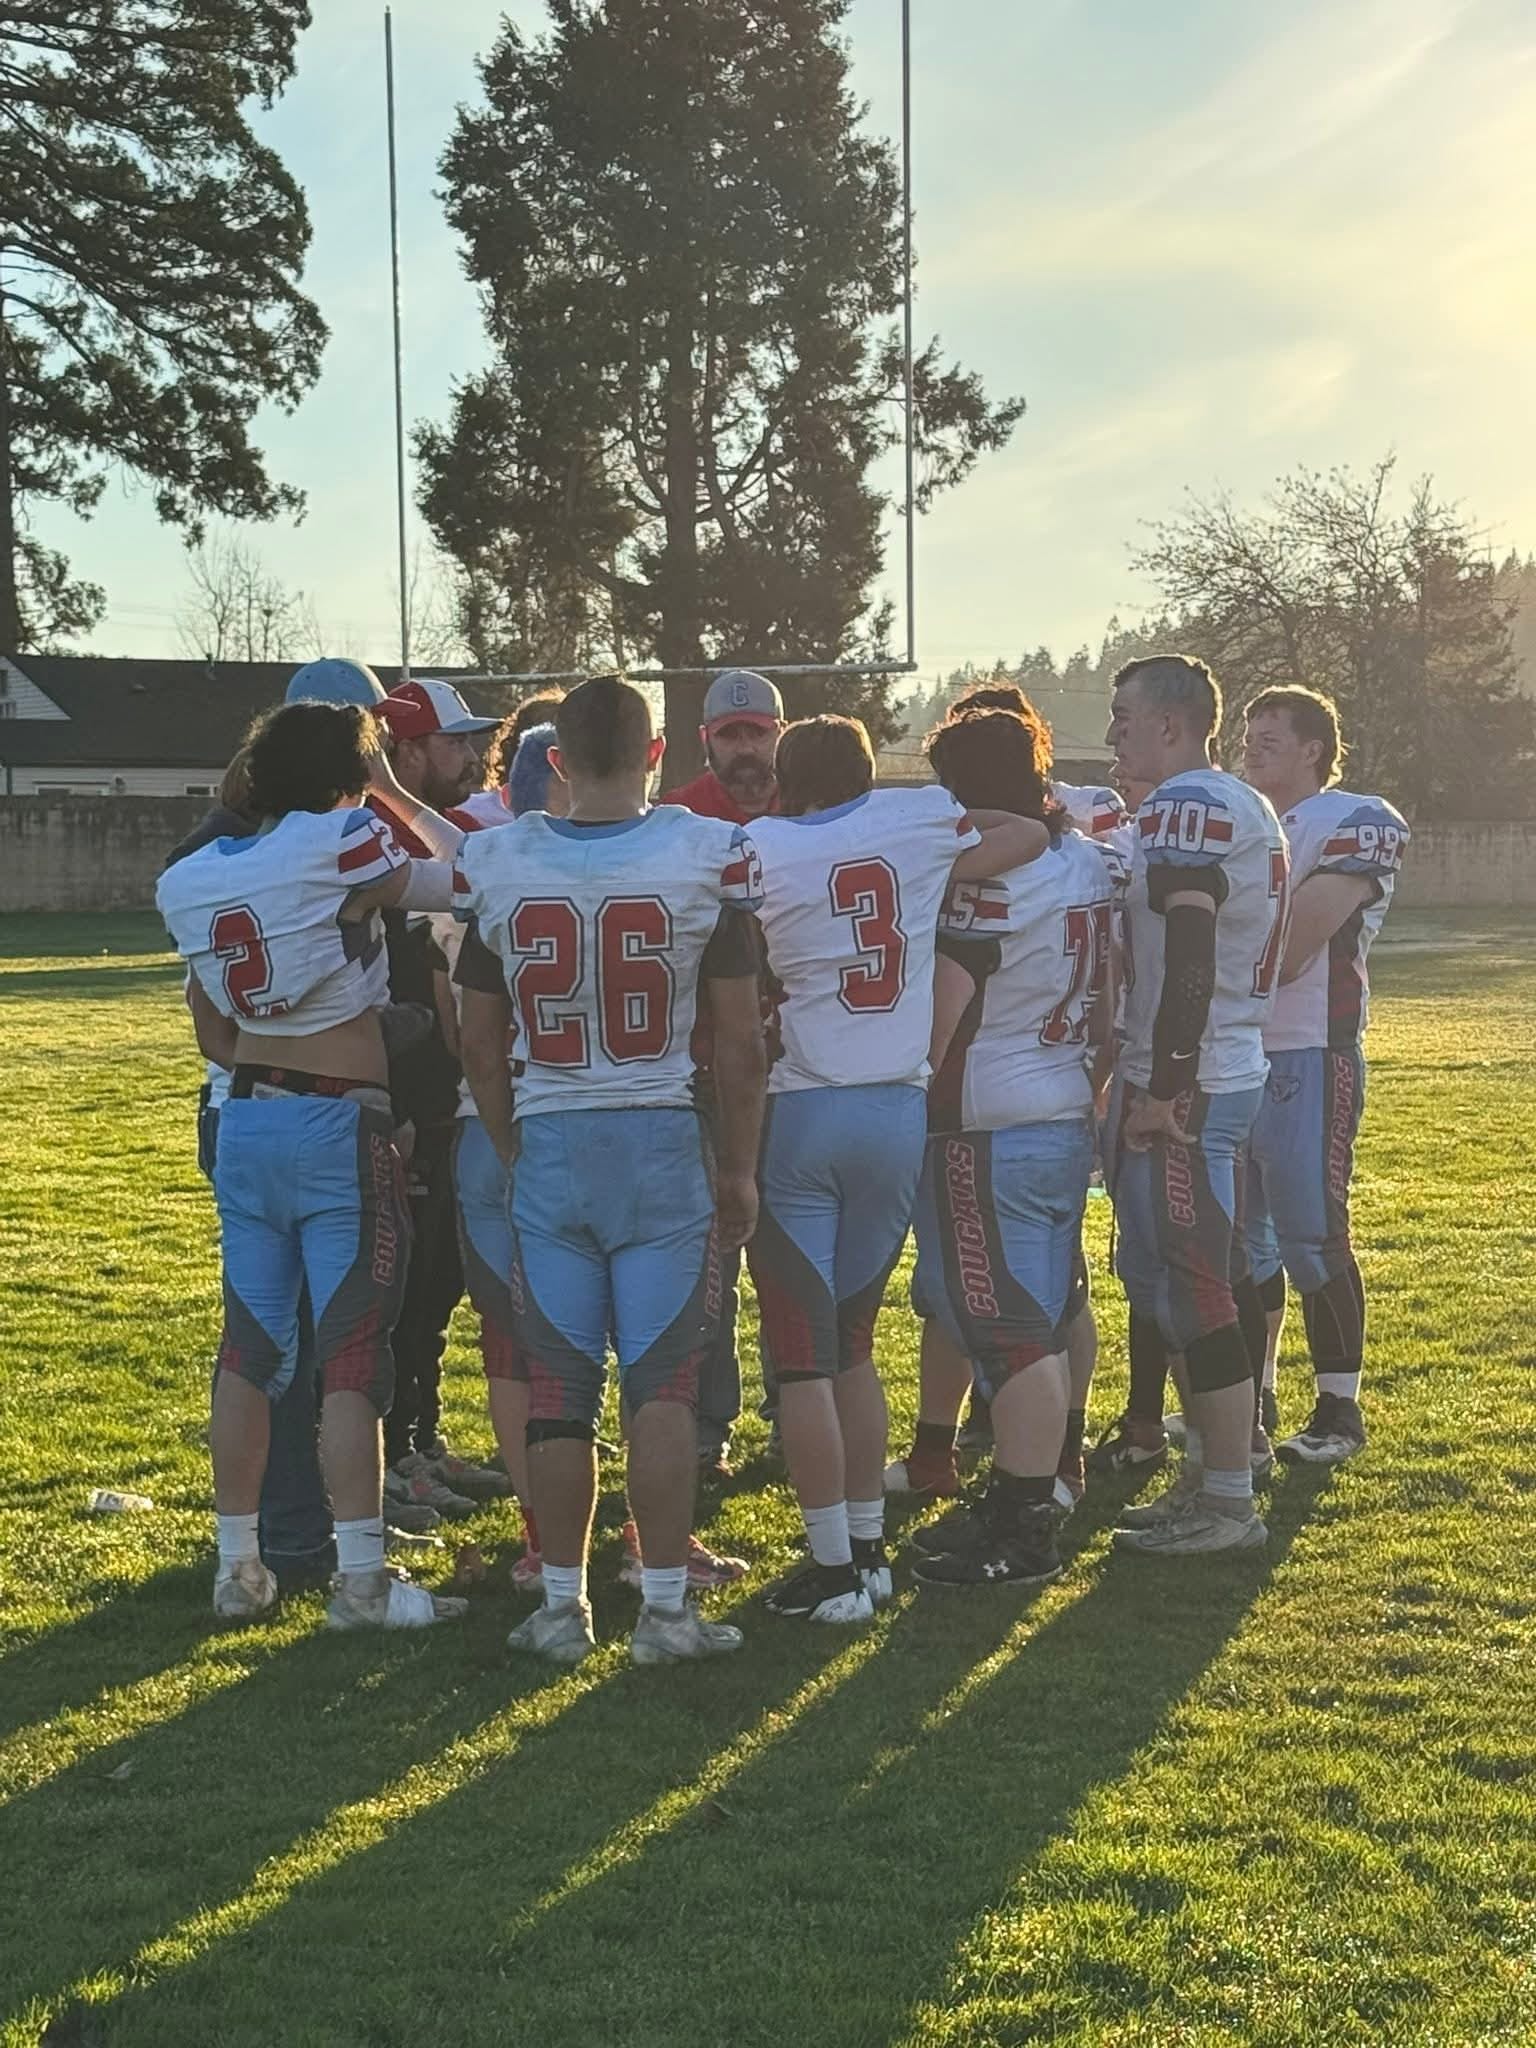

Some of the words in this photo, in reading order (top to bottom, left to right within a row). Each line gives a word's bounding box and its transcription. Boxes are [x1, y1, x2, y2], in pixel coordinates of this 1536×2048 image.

[731, 681, 748, 707] C
[367, 816, 409, 870] 2
[1152, 800, 1209, 852] 70
[1356, 823, 1402, 868] 99
[209, 904, 290, 1019] 2
[828, 856, 908, 1015] 3
[508, 894, 677, 1069] 26
[945, 1139, 1000, 1319] COUGARS
